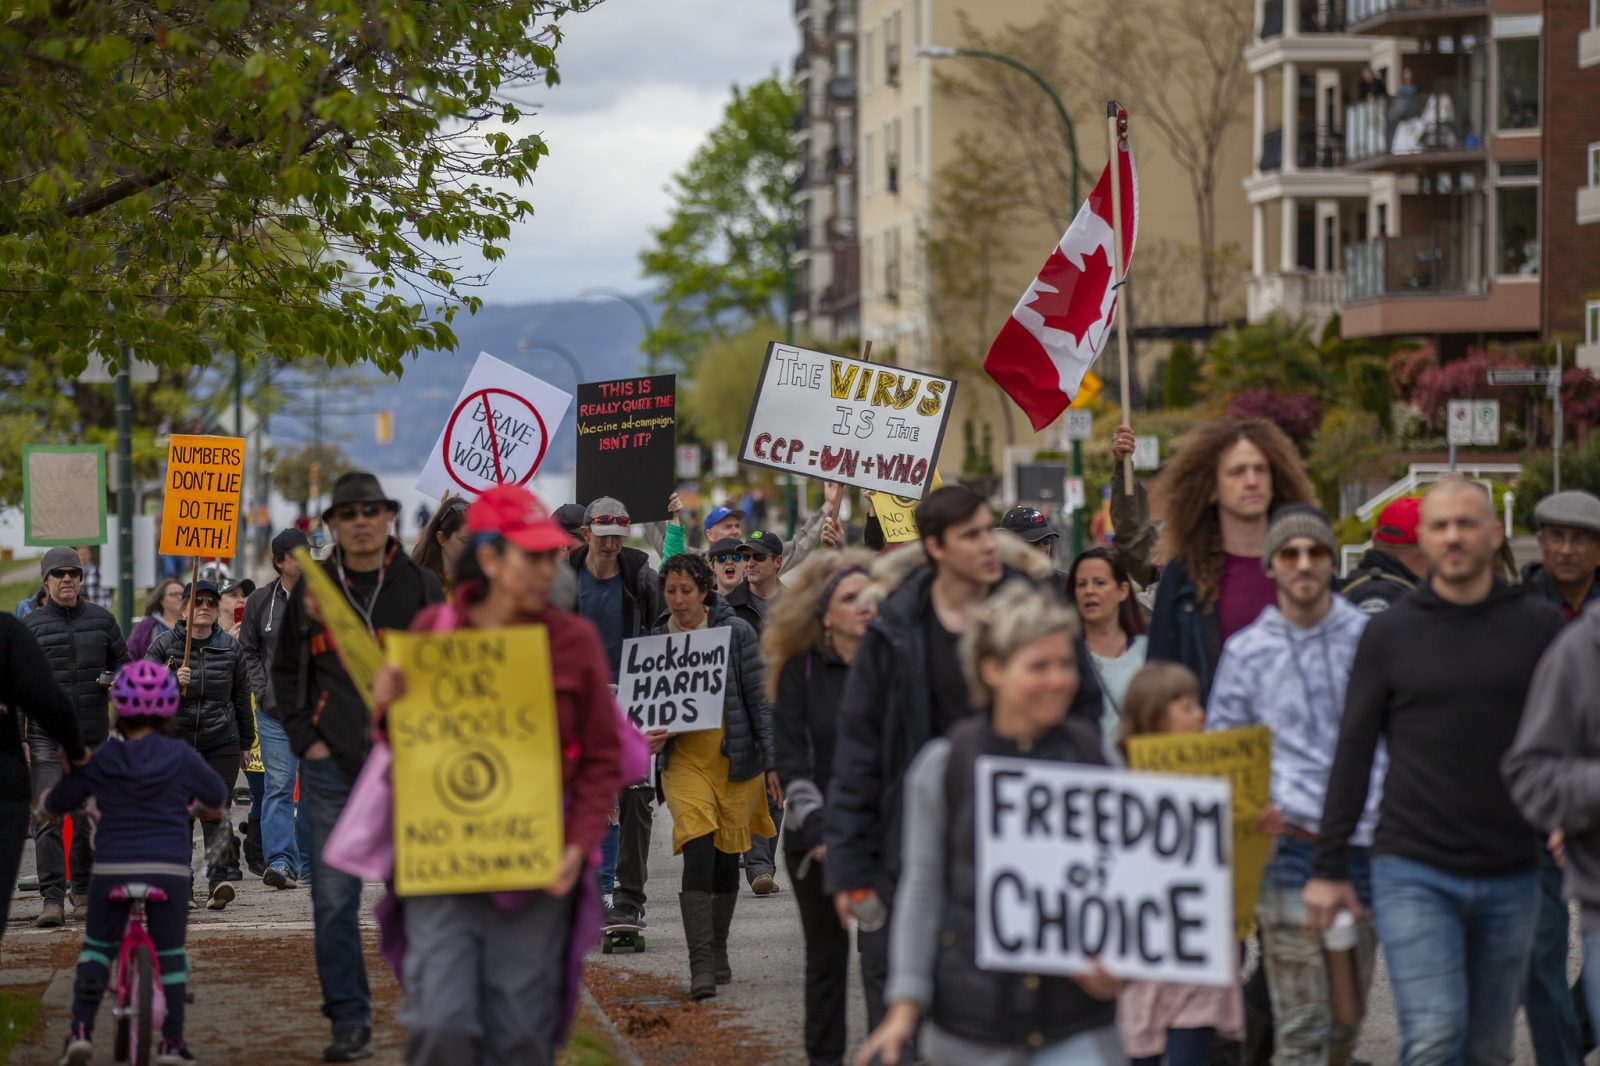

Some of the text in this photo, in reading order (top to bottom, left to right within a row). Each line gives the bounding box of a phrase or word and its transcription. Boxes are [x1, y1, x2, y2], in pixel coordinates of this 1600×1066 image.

[599, 380, 652, 398] THIS IS
[776, 349, 946, 416] THE VIRUS
[579, 395, 673, 417] REALLY QUITE THE
[472, 402, 535, 445] BRAVE
[577, 421, 618, 436] Vaccine
[833, 406, 920, 442] IS THE
[172, 446, 241, 466] NUMBERS
[471, 426, 519, 460] NEW
[599, 432, 652, 450] ISN'T IT?
[453, 440, 517, 485] WORLD
[172, 470, 241, 493] DON'T LIE
[179, 499, 235, 521] DO THE
[882, 512, 904, 524] NO
[175, 525, 231, 549] MATH!
[626, 633, 725, 674] Lockdown
[632, 668, 723, 702] HARMS
[627, 698, 699, 729] KIDS
[990, 770, 1228, 868] FREEDOM
[990, 871, 1206, 965] CHOICE
